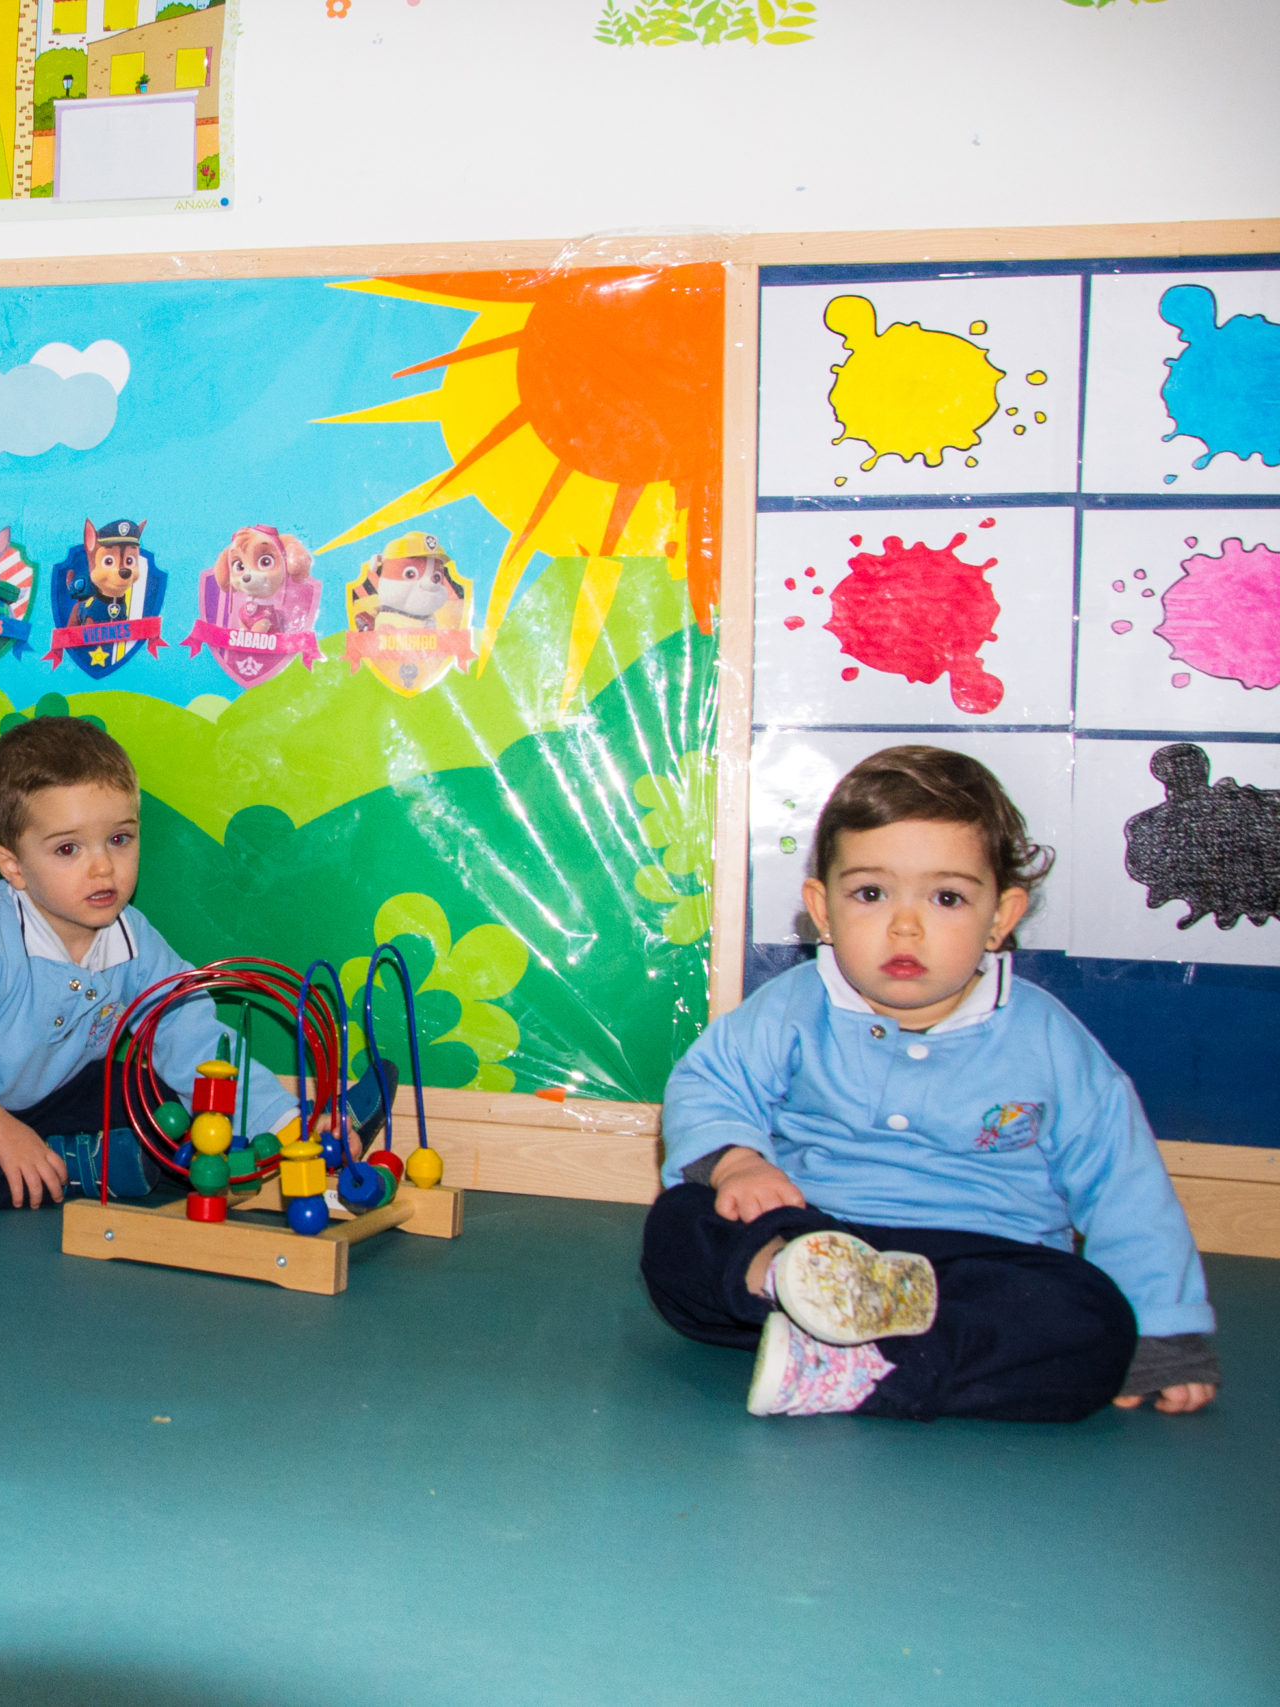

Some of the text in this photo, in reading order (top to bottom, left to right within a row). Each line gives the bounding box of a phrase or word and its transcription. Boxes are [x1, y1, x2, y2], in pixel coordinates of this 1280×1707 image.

[174, 199, 220, 210] ANAYA
[82, 623, 131, 643] VIERNES
[228, 628, 277, 650] SÁBADO
